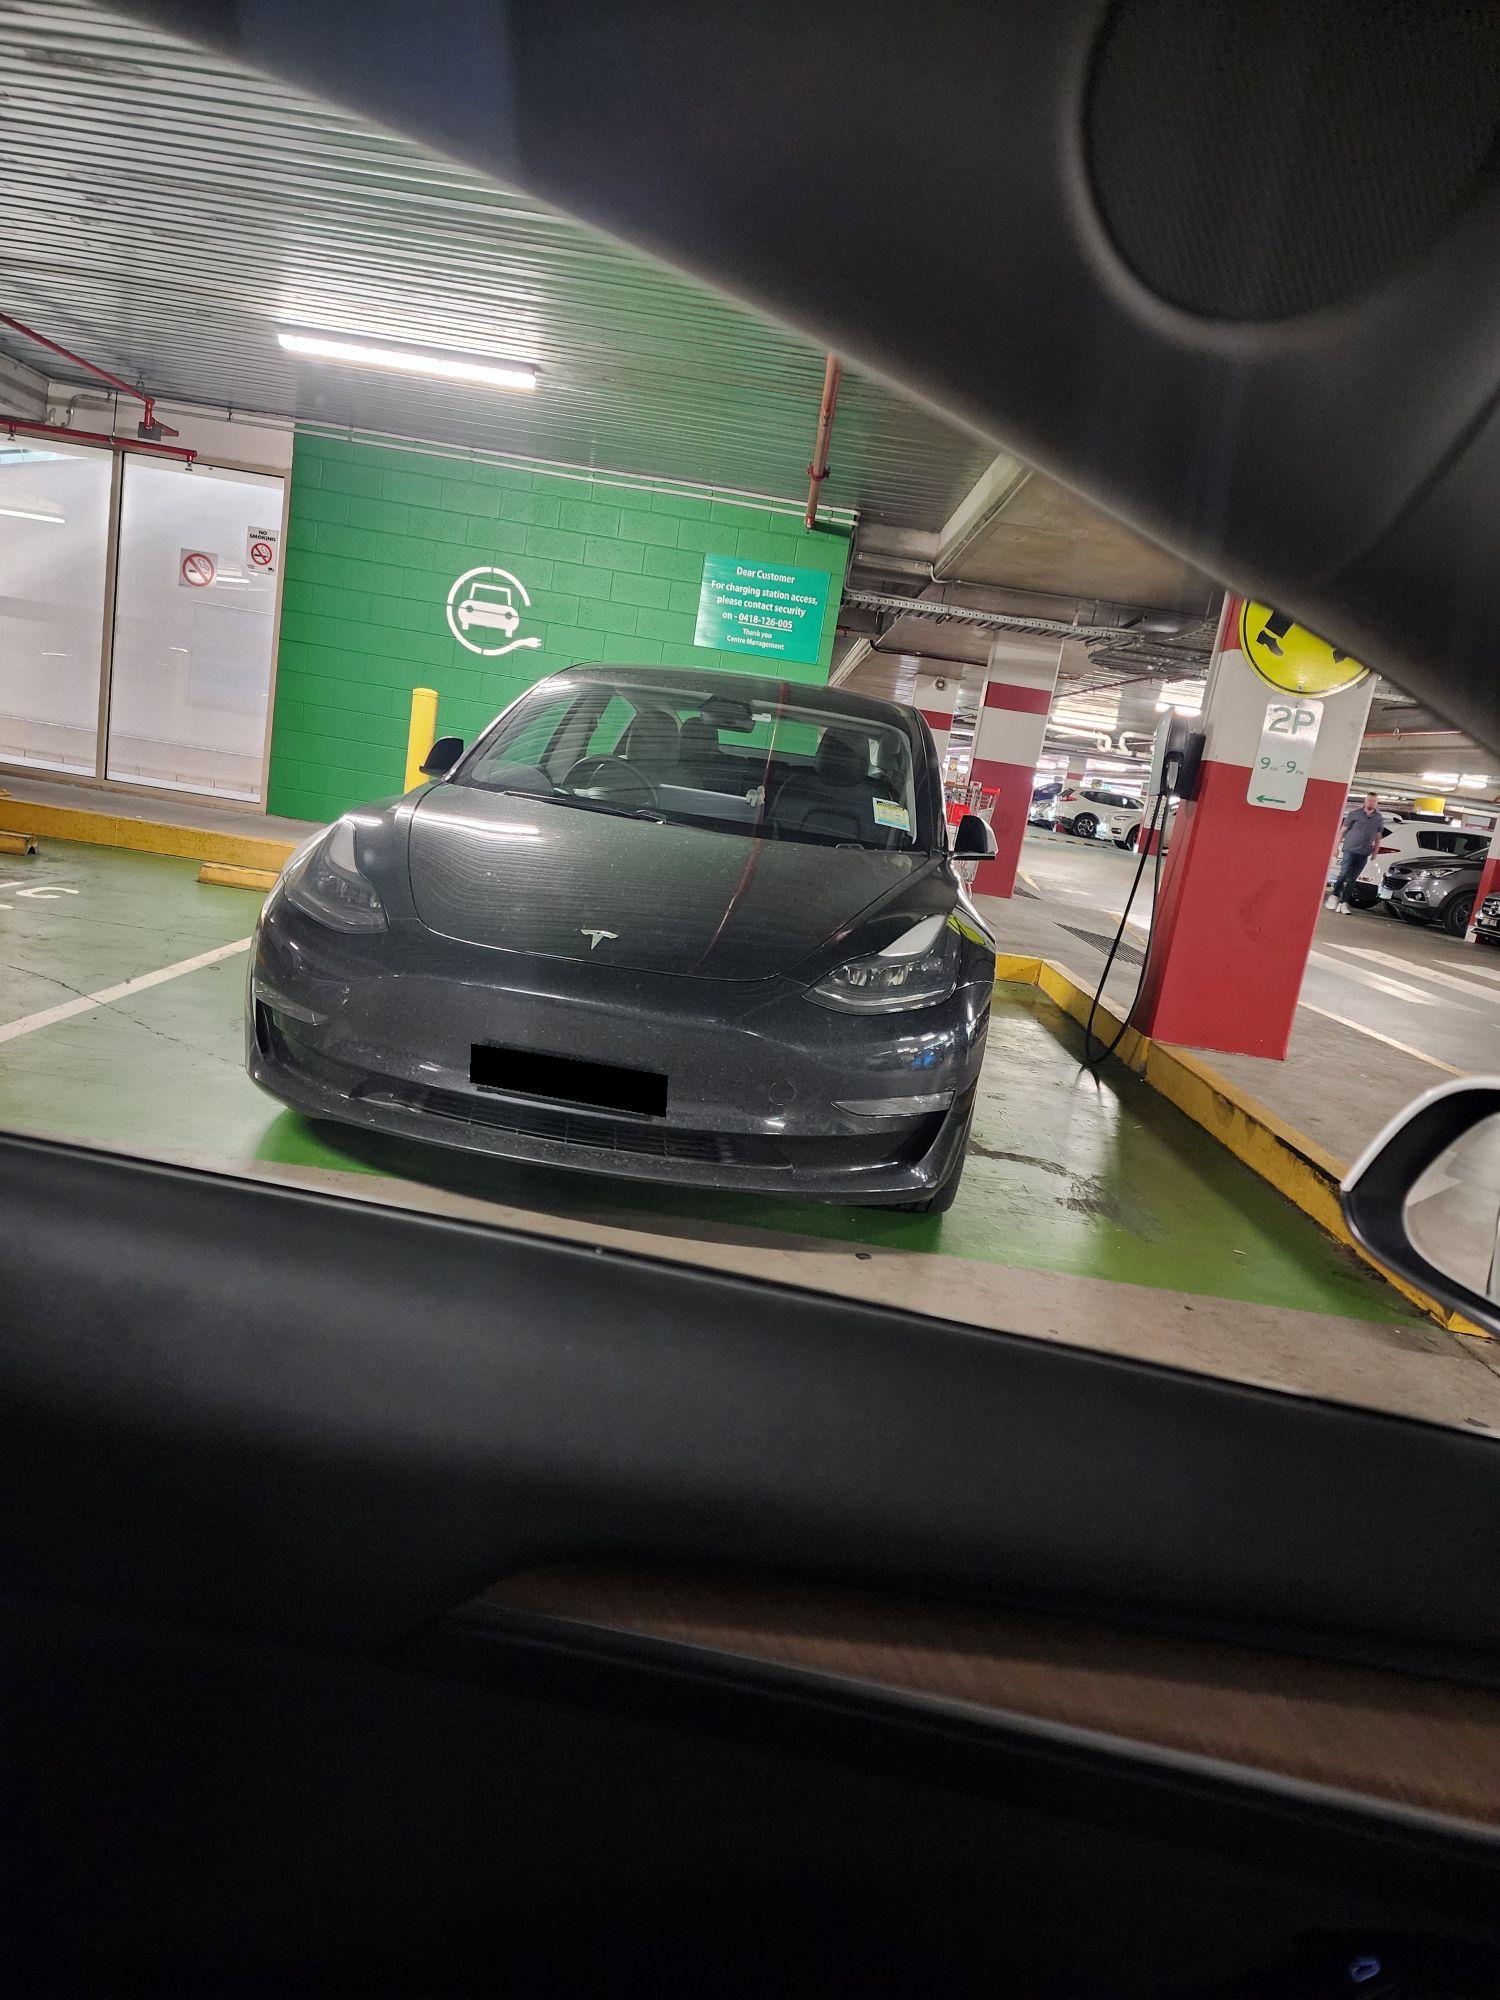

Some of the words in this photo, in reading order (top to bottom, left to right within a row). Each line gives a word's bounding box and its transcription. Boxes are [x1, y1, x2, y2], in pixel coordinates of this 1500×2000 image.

[736, 567, 756, 577] Dear
[756, 570, 795, 583] Customer
[711, 580, 725, 590] For
[725, 582, 761, 596] charging
[761, 588, 790, 600] station
[790, 593, 818, 606] access,
[716, 596, 742, 606] please
[743, 600, 773, 611] contact
[774, 603, 806, 618] security
[722, 611, 733, 620] on
[738, 612, 793, 631] 0418-126-005
[726, 635, 745, 644] Centre
[746, 638, 784, 650] Management
[742, 628, 761, 637] Thank
[761, 631, 773, 639] you
[1268, 706, 1316, 735] 2P
